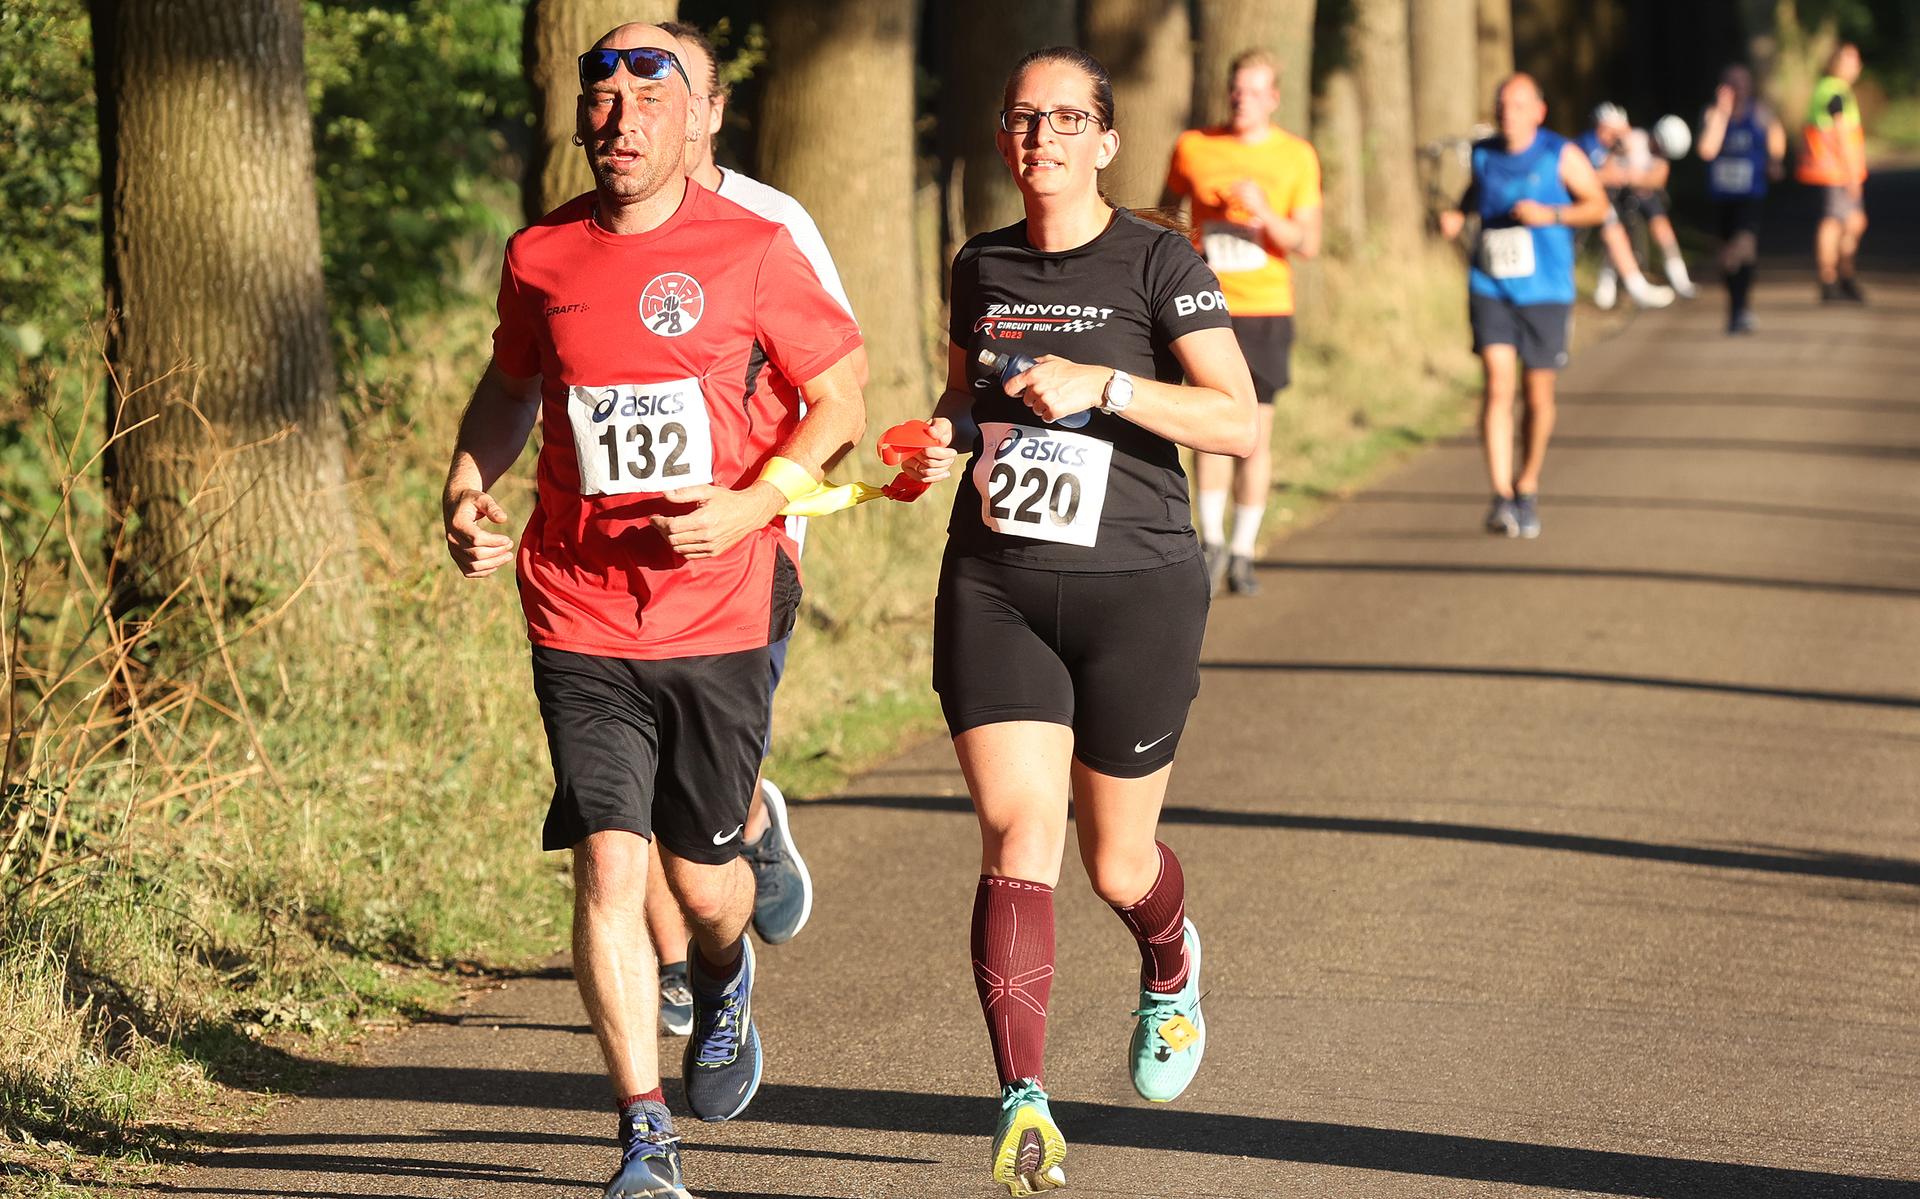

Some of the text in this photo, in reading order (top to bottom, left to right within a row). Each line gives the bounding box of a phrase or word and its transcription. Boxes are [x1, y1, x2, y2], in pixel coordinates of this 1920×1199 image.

[546, 303, 580, 317] CRAFT
[986, 304, 1114, 319] ZANDVOORT
[997, 321, 1053, 332] CIRCUIT RUN
[999, 330, 1023, 339] 2023
[620, 391, 684, 417] asics
[599, 422, 690, 481] 132
[1020, 438, 1088, 467] asics
[989, 462, 1081, 528] 220
